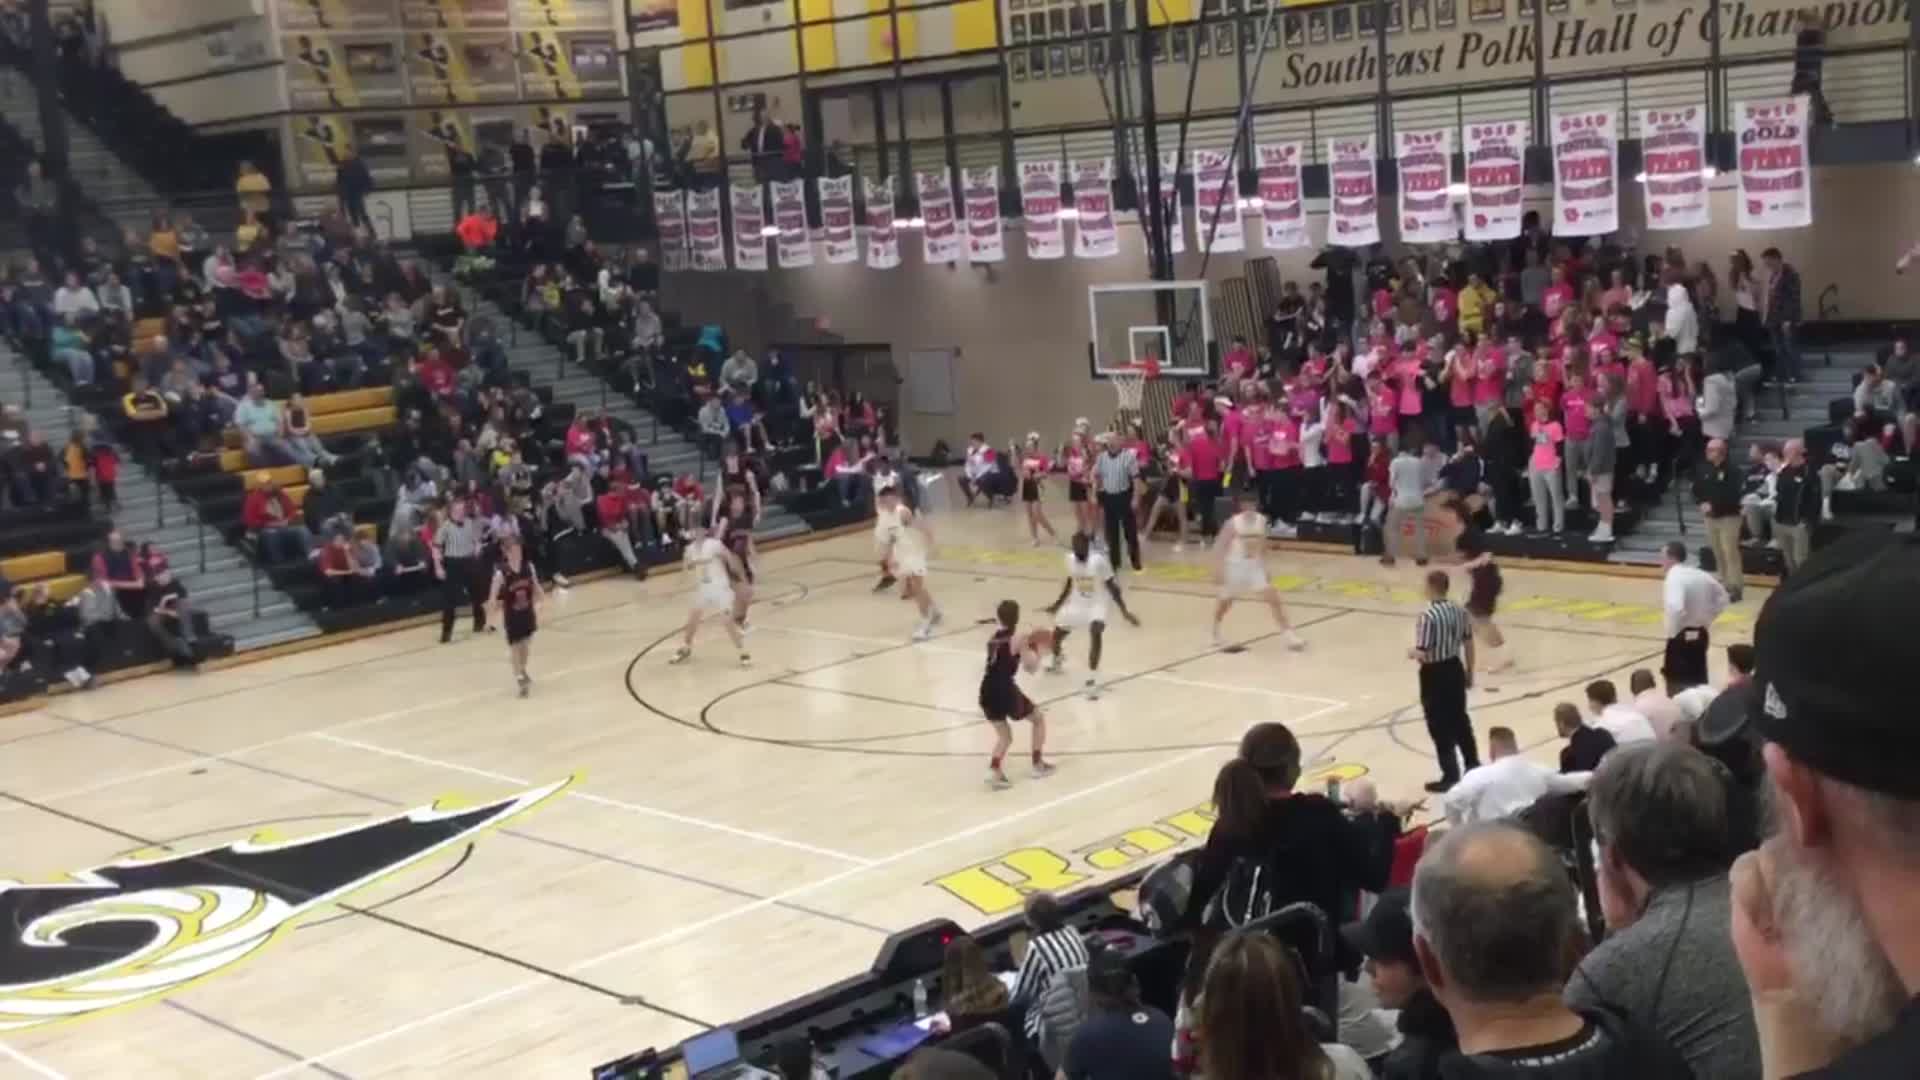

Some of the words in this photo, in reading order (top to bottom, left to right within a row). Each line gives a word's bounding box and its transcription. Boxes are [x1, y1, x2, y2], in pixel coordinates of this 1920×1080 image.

[1281, 42, 1446, 89] Southeast
[1455, 24, 1536, 70] Polk
[1550, 13, 1638, 59] Hall
[1647, 8, 1694, 56] of
